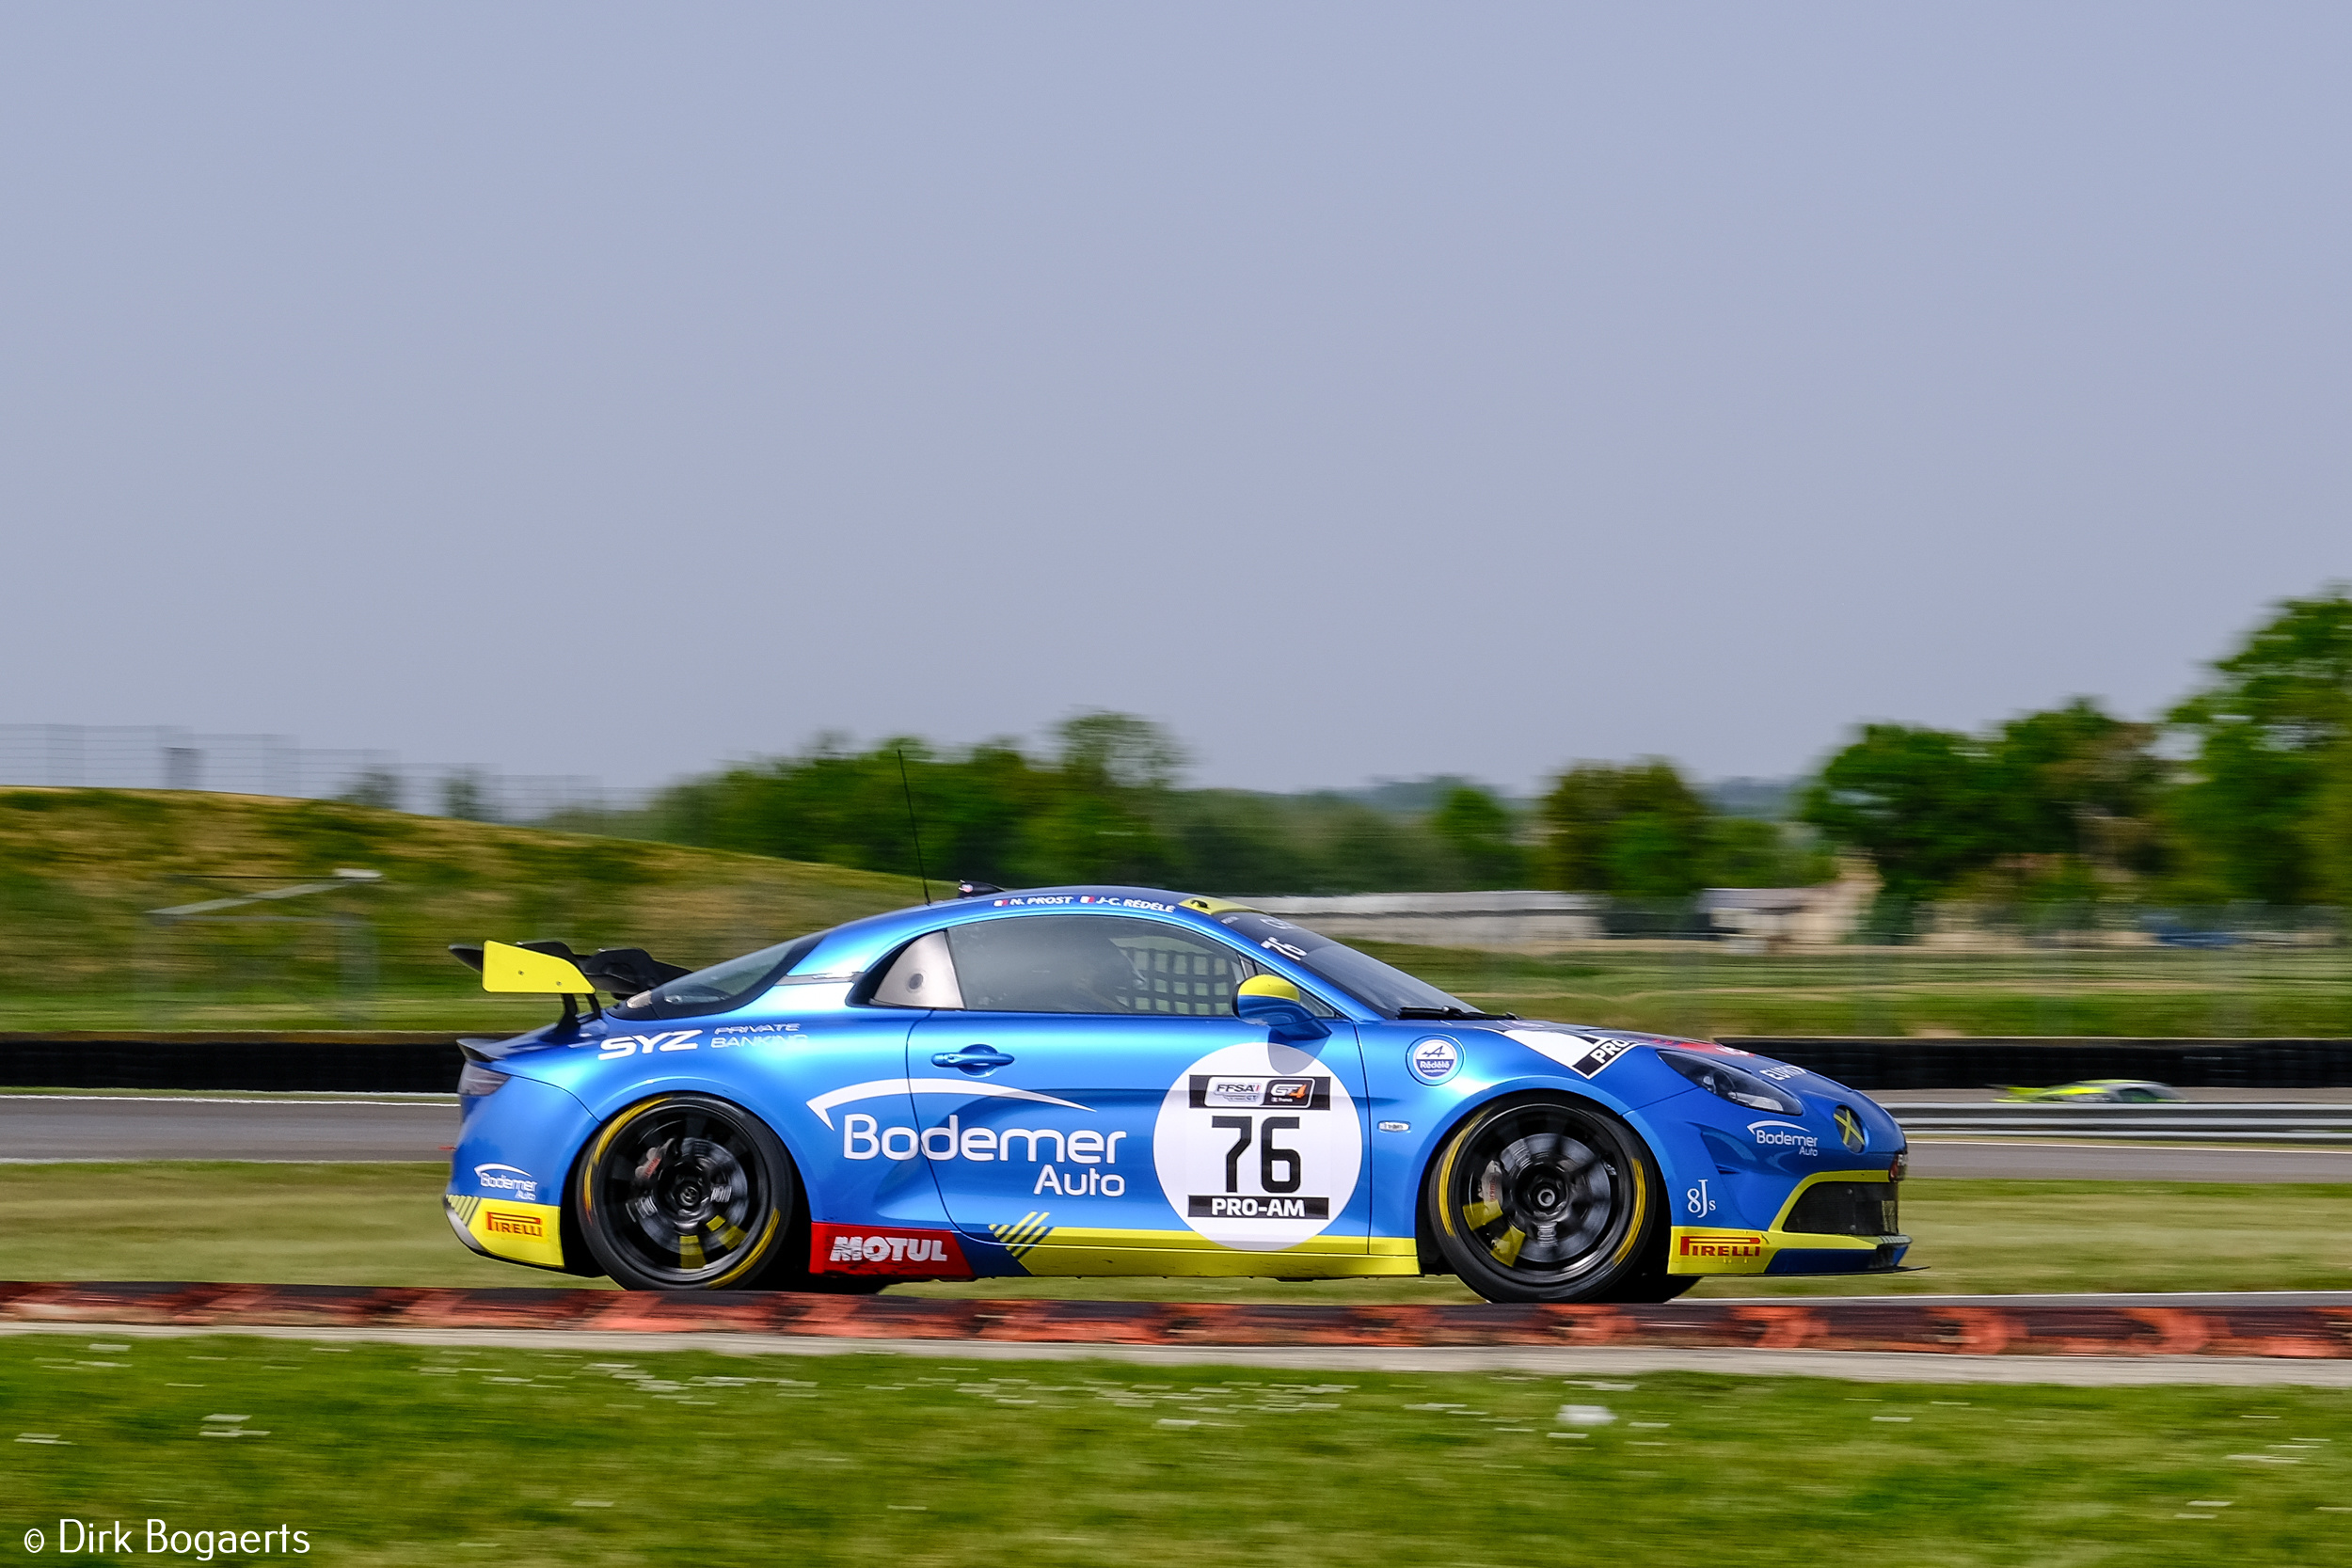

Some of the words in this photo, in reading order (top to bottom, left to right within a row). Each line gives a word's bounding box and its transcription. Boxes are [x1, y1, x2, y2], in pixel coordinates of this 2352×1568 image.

[1027, 896, 1073, 905] PROST
[1260, 936, 1308, 961] 76
[714, 1022, 801, 1035] PRIVATE
[597, 1029, 704, 1061] SYZ
[1216, 1084, 1255, 1092] FFSA
[1270, 1083, 1307, 1099] GT4
[843, 1114, 1127, 1164] Bodemer
[1756, 1130, 1819, 1148] Bodemer
[1212, 1116, 1301, 1193] 76
[1799, 1146, 1819, 1157] Auto
[481, 1172, 537, 1192] Bodemer
[1033, 1164, 1125, 1197] Auto
[515, 1189, 536, 1201] Auto
[1211, 1197, 1306, 1217] PRO-AM
[485, 1212, 543, 1237] PIRELLI
[829, 1235, 948, 1262] MOTUL
[1679, 1236, 1761, 1257] PIRELLI
